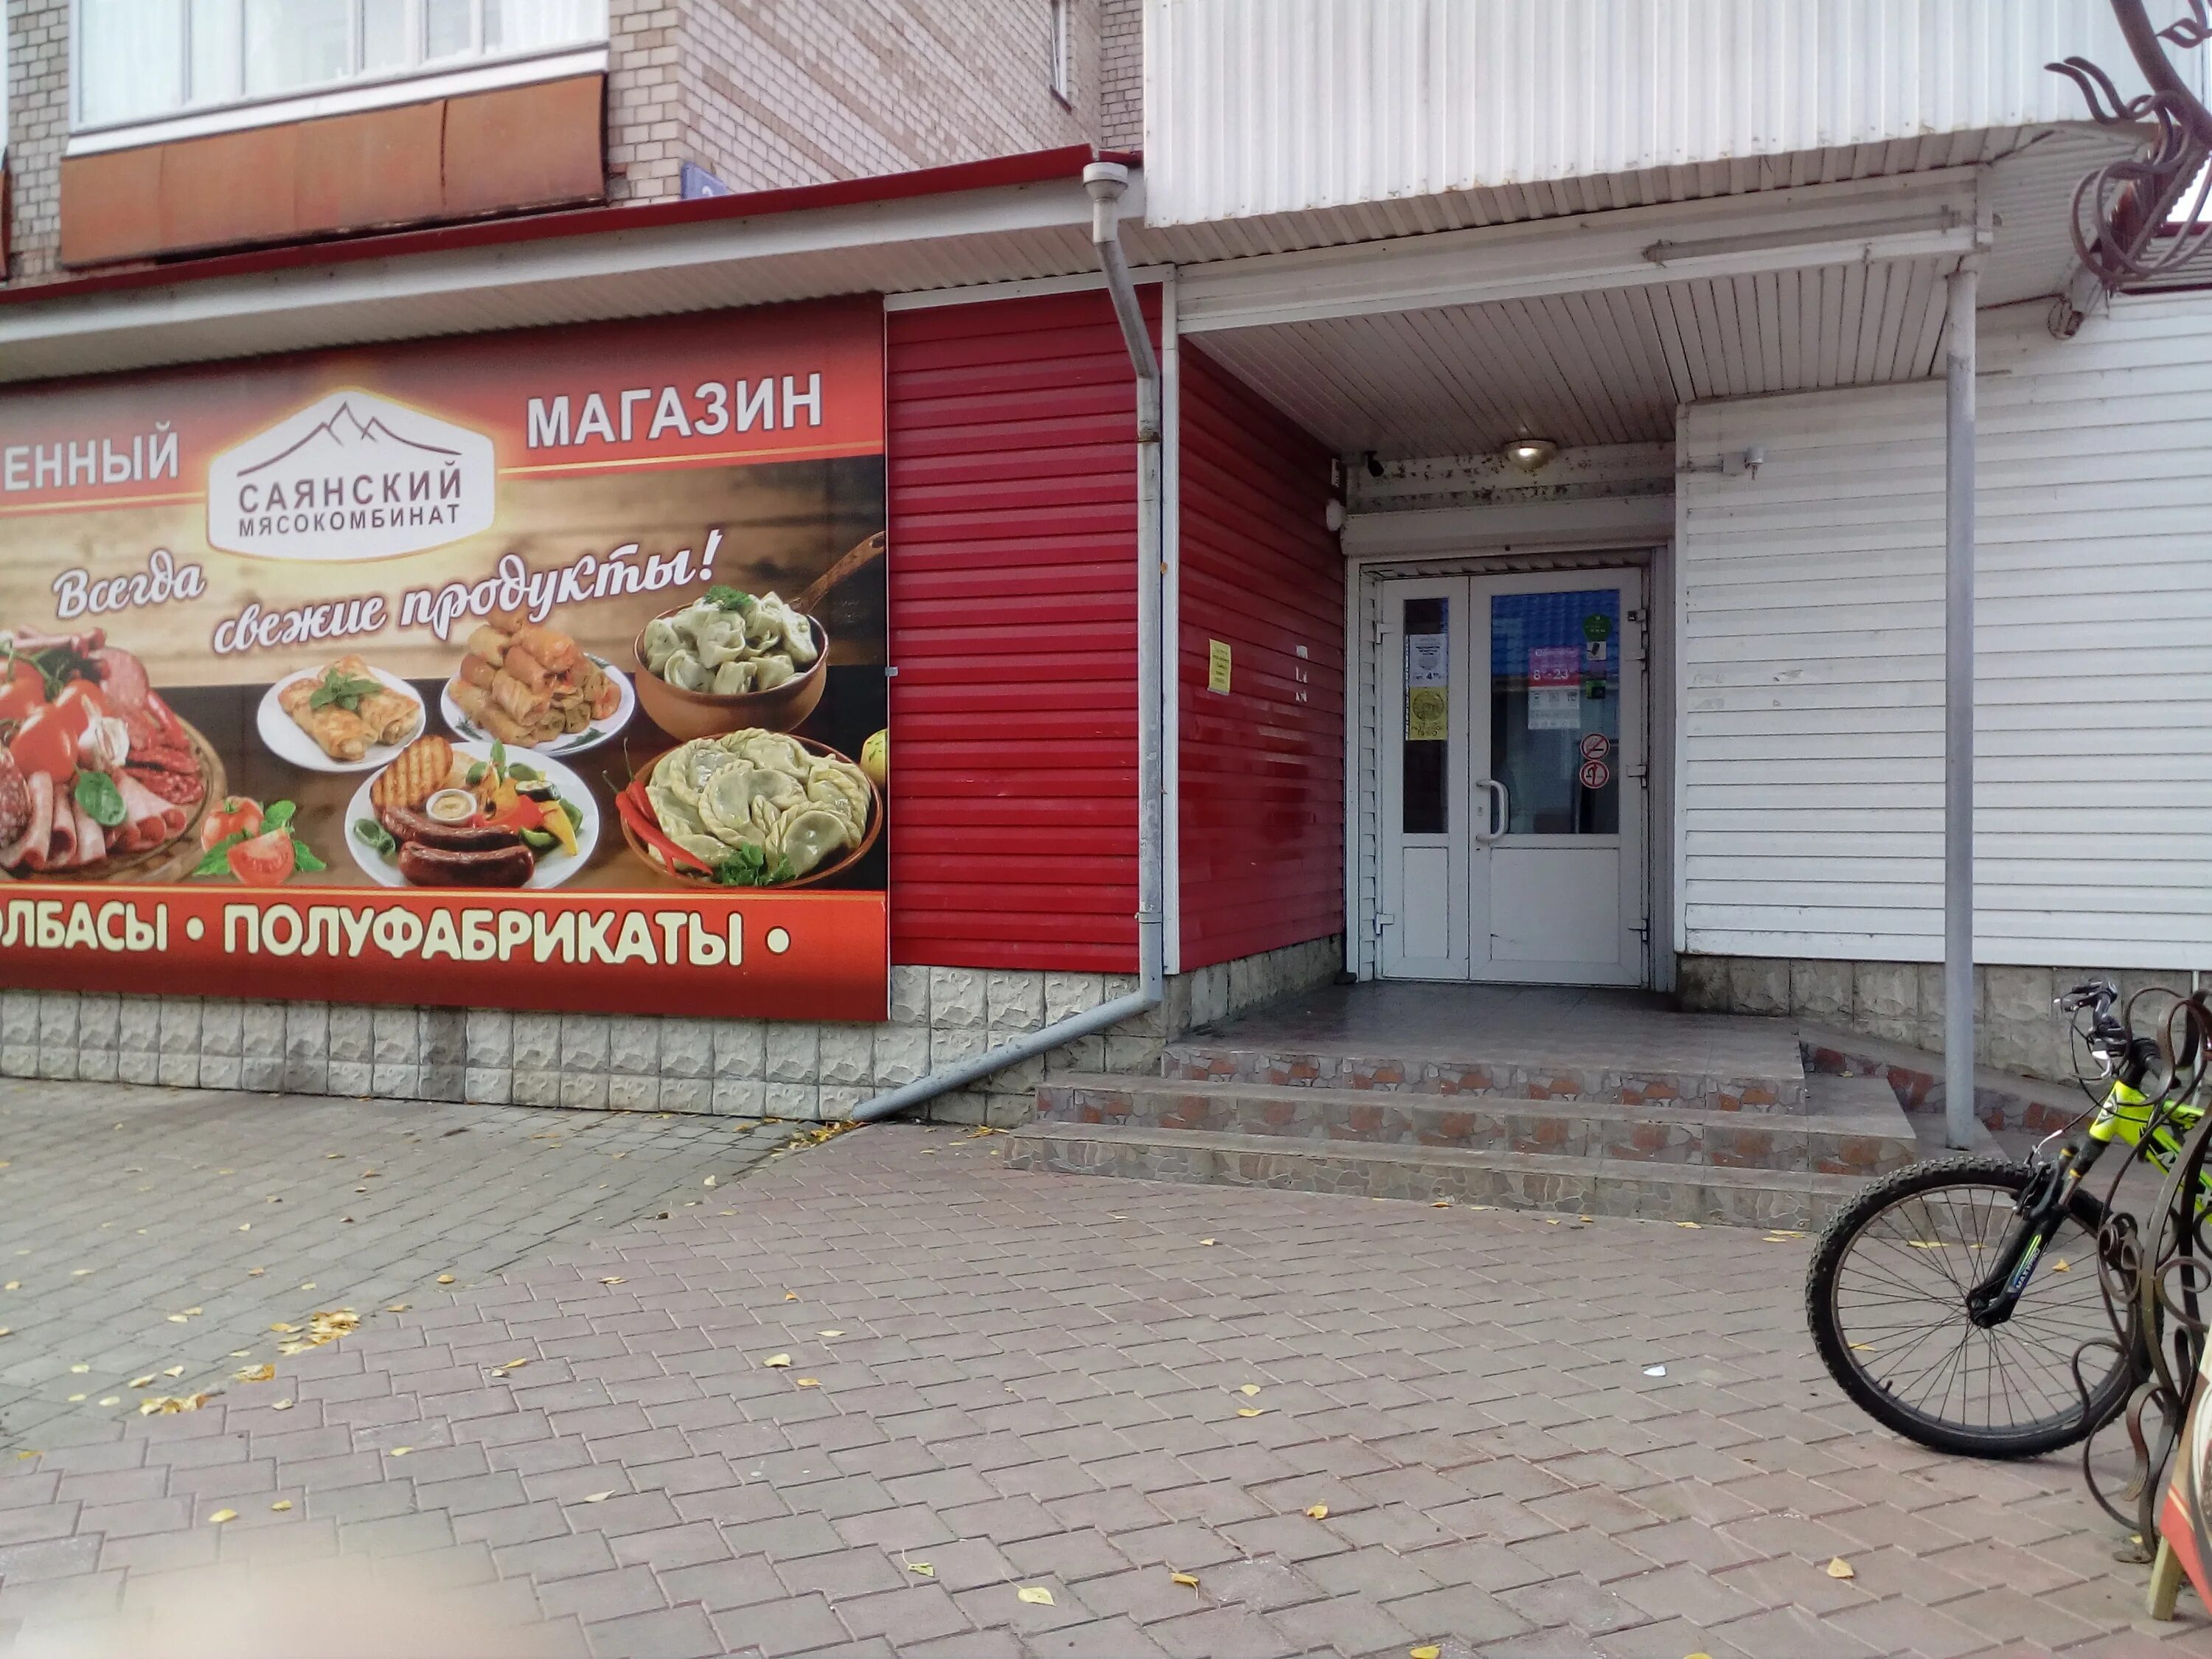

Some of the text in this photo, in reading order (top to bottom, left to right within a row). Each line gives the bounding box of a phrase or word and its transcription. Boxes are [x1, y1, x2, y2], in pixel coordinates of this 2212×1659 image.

[526, 372, 822, 449] МАГАЗИН
[4, 420, 179, 491] ЕННЫЙ
[238, 460, 462, 513] САЯНСКИЙ
[238, 503, 460, 538] МЯСОКОМБИНАТ
[53, 549, 206, 619] Всегда
[212, 528, 723, 655] свежие продукты!
[0, 899, 744, 967] ЛБАСЫ ПОЛУФАБРИКАТЫ
